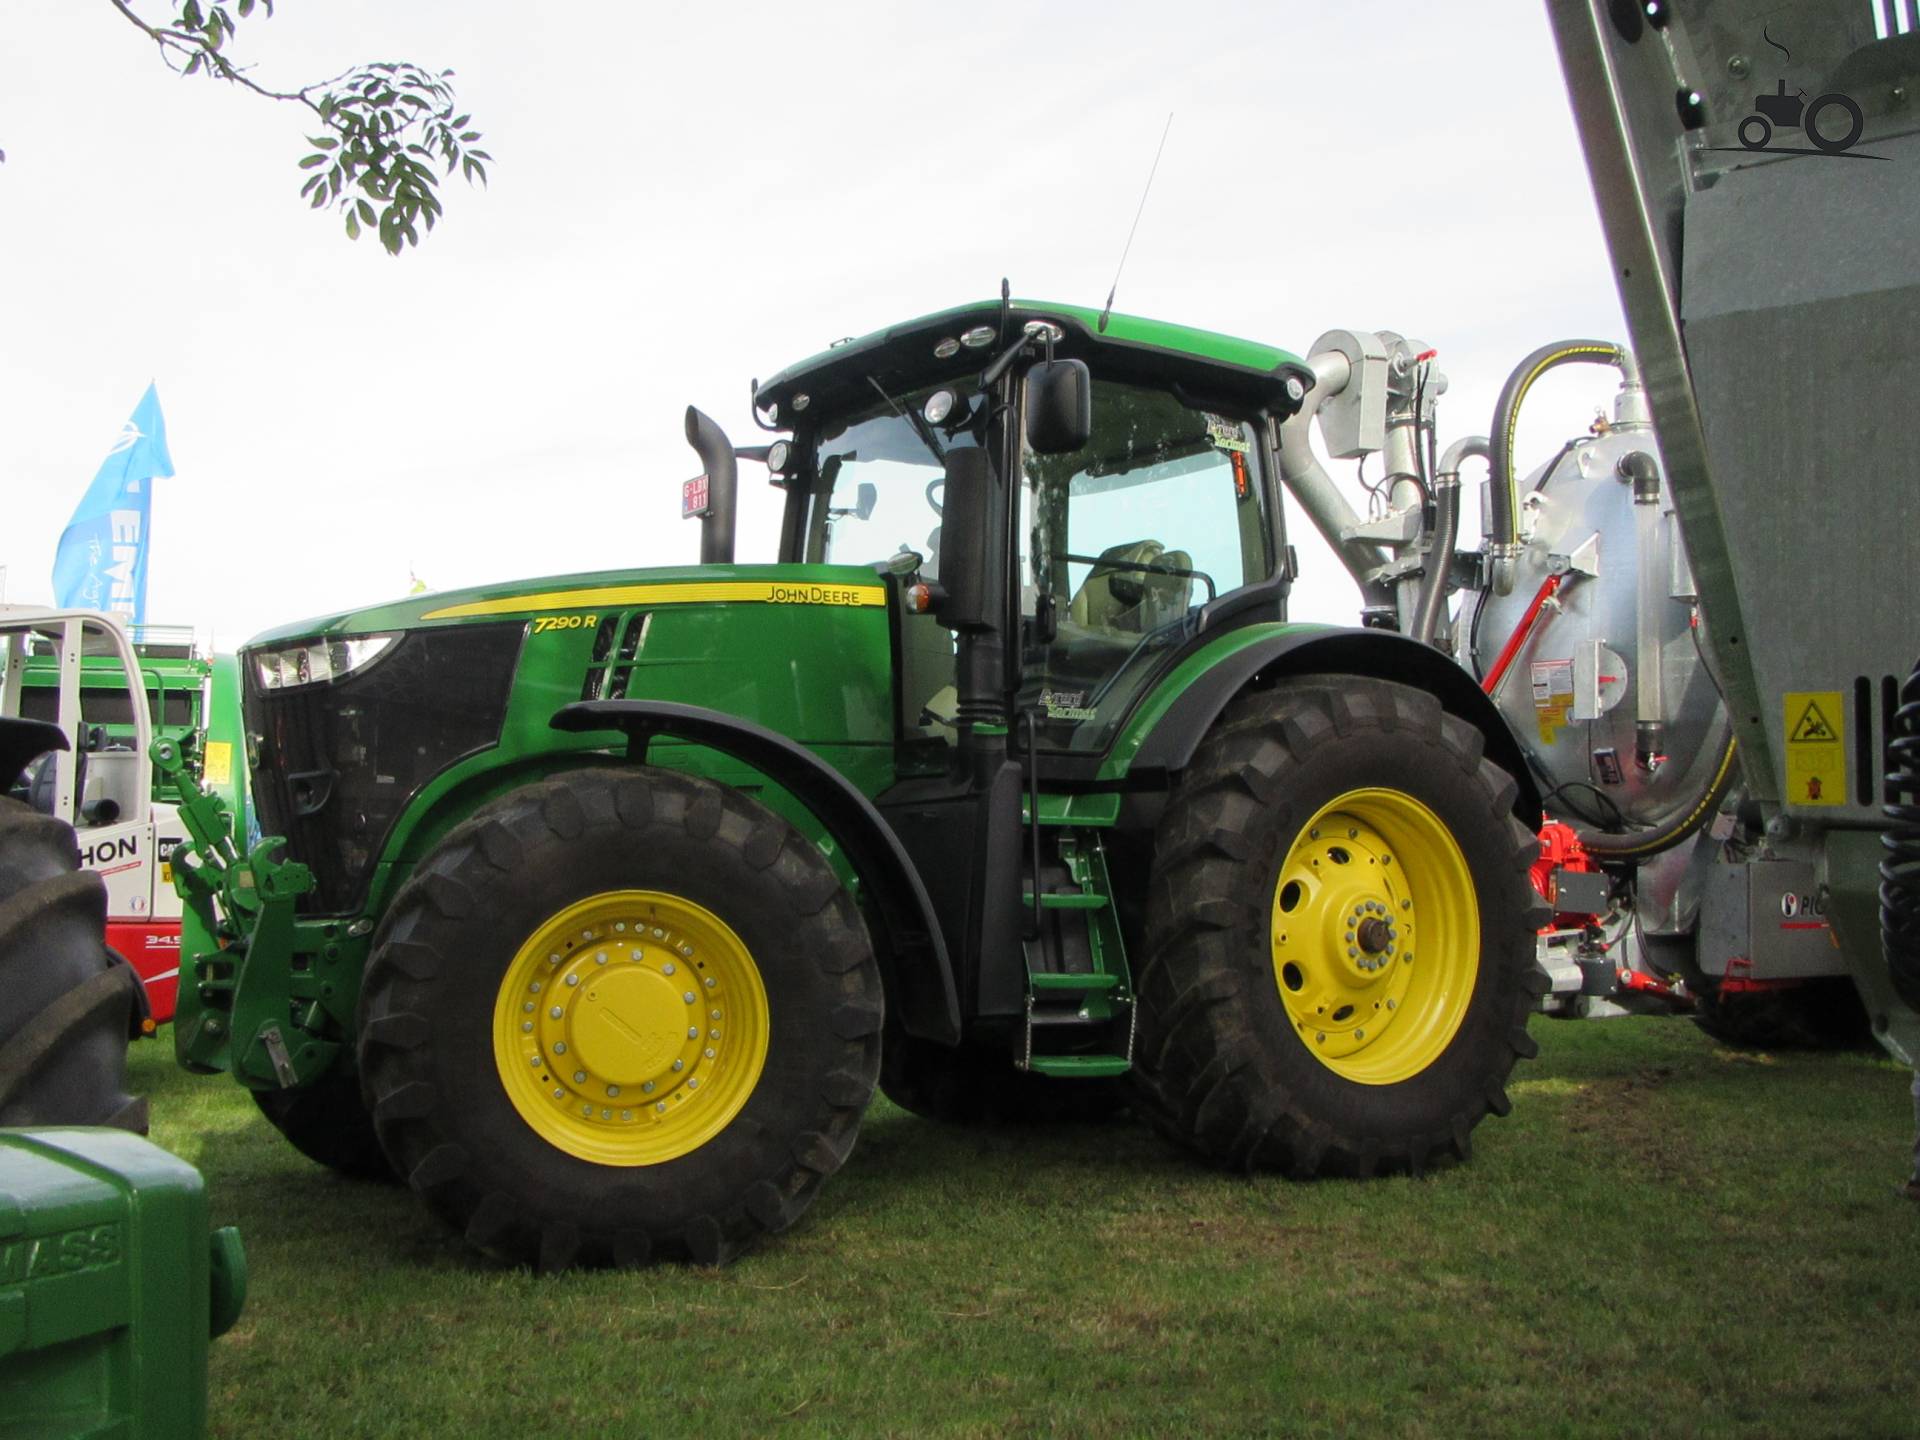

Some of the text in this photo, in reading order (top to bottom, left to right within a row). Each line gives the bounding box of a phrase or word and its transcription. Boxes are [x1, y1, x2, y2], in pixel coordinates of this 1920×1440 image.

[767, 586, 860, 604] JOHN DEERE
[534, 615, 597, 634] 7290 R
